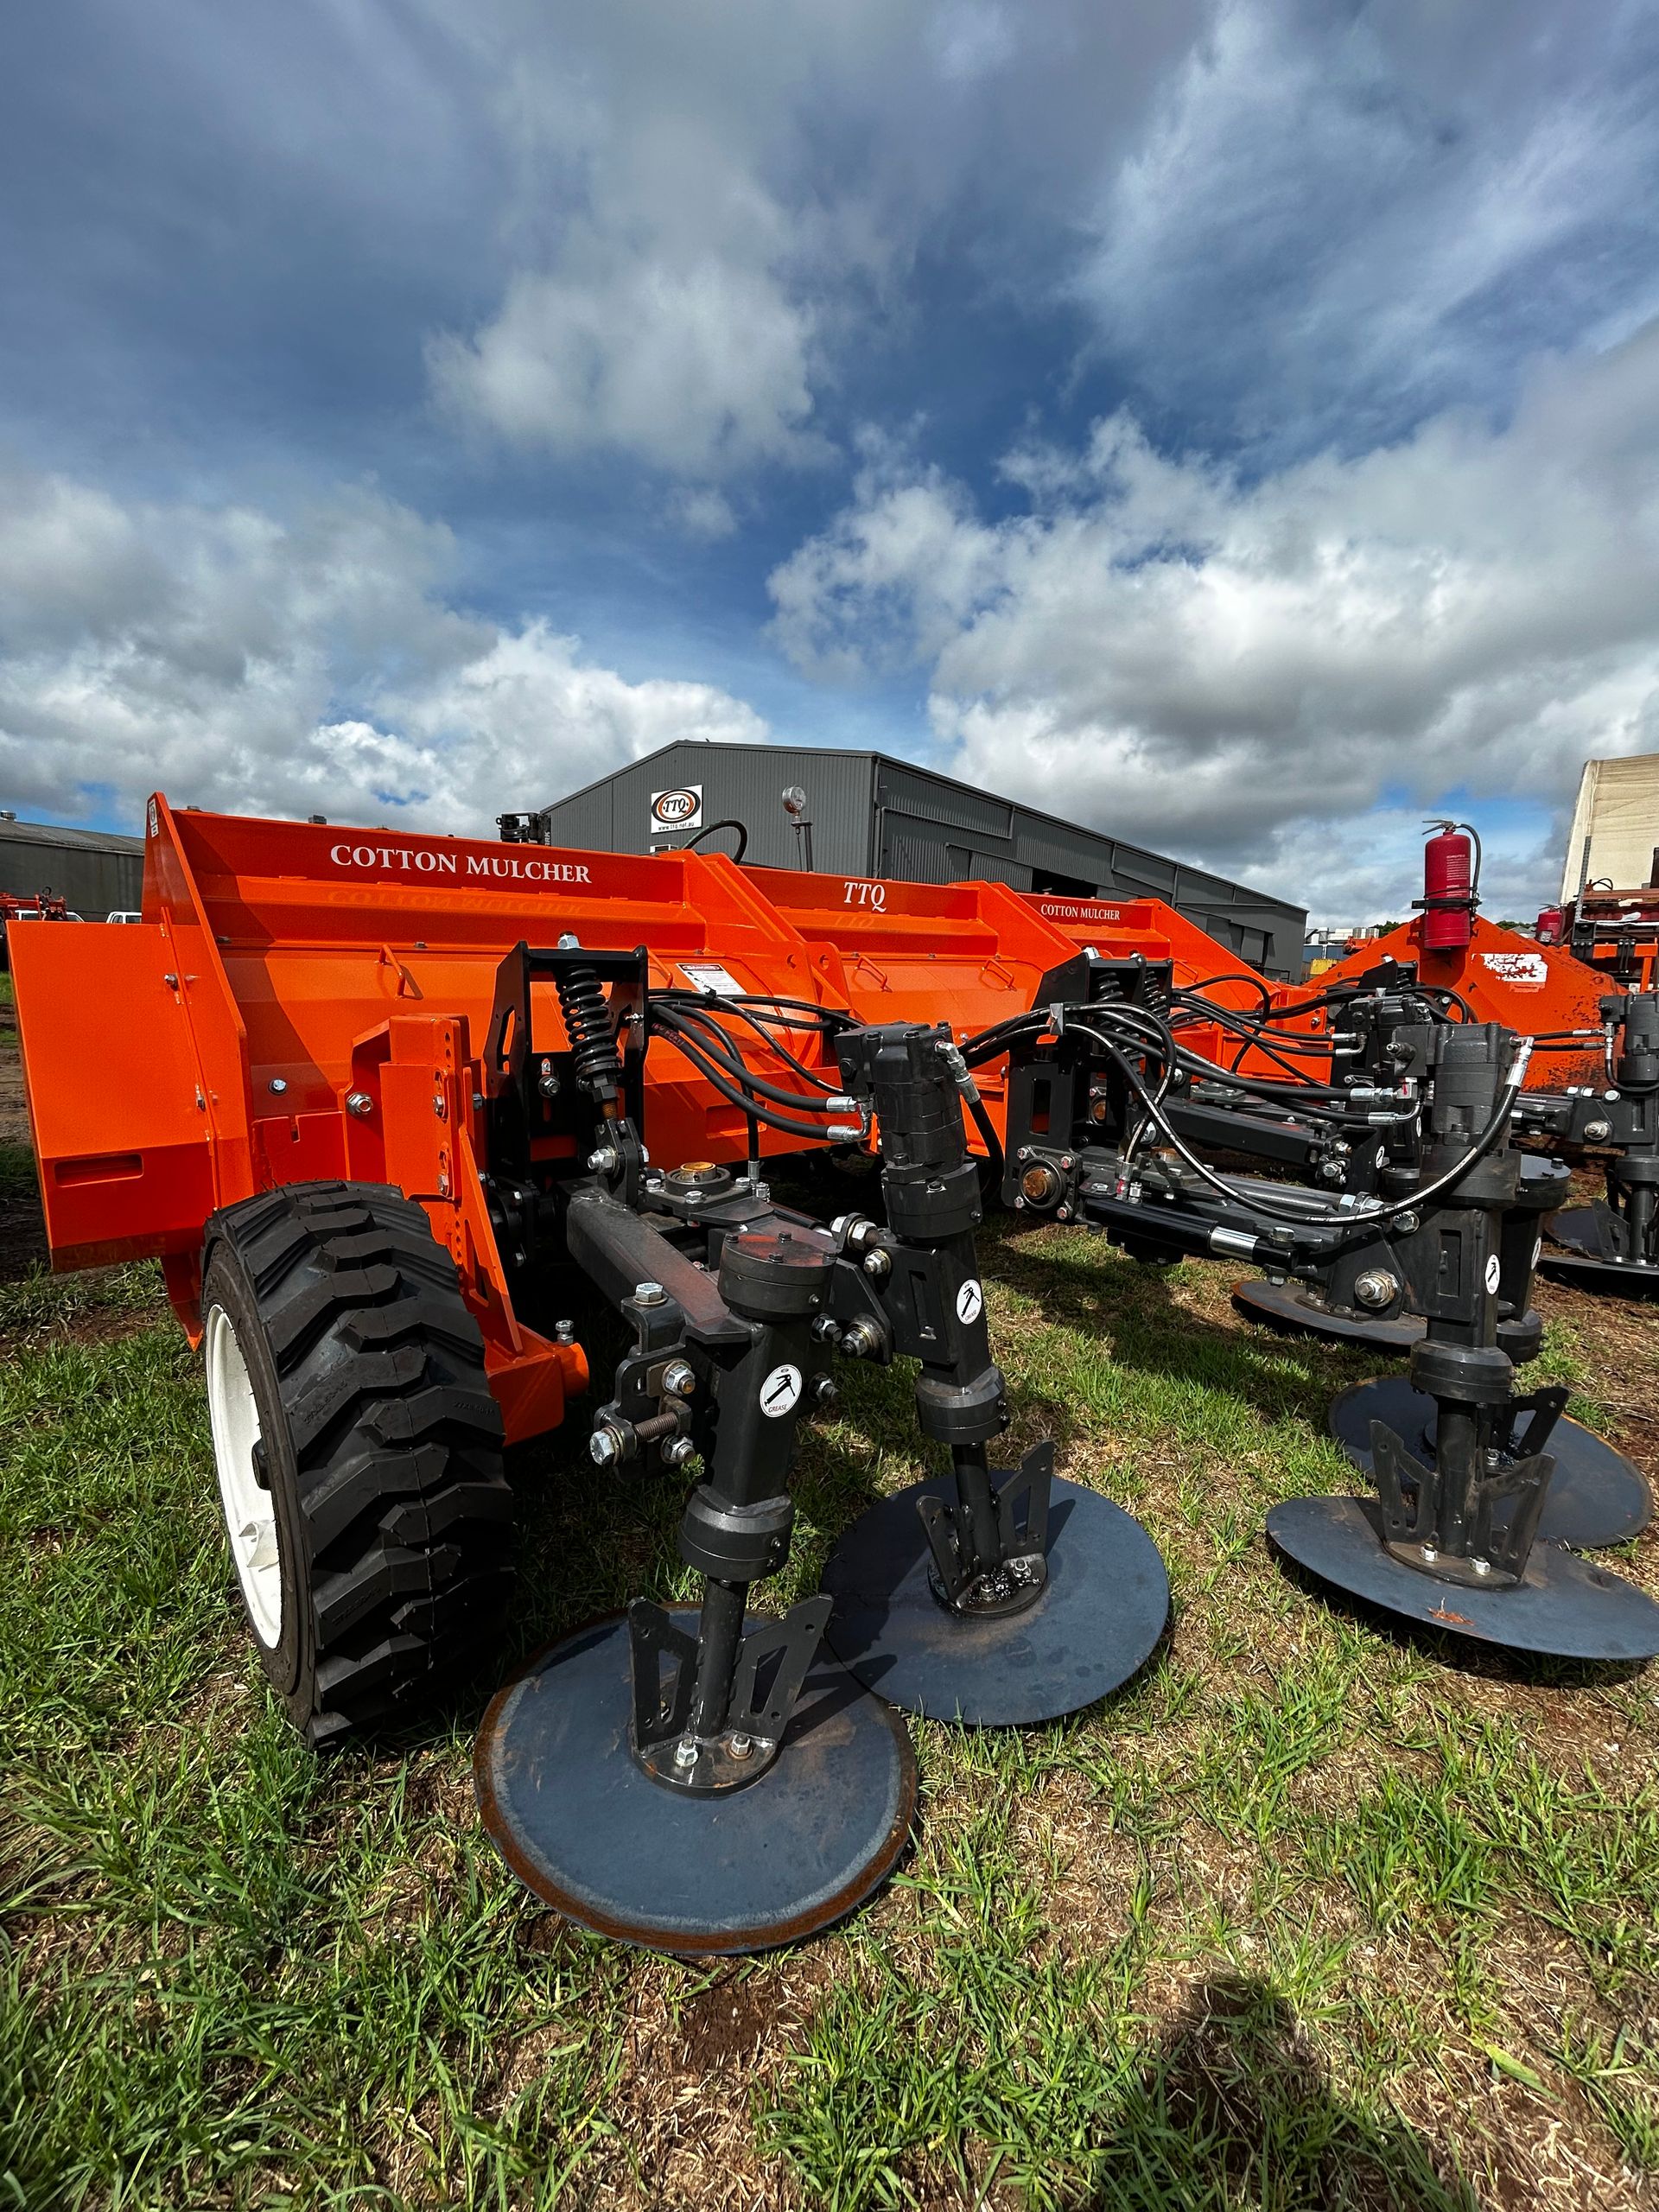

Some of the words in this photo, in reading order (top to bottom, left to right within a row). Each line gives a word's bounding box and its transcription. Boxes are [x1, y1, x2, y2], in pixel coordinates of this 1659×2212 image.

[664, 798, 687, 814] TTQ
[330, 844, 458, 874] COTTON
[465, 855, 593, 884] MULCHER
[843, 881, 887, 913] TTQ
[1040, 904, 1078, 918] COTTON
[1080, 907, 1121, 921] MULCHER
[768, 1403, 787, 1413] GREASE
